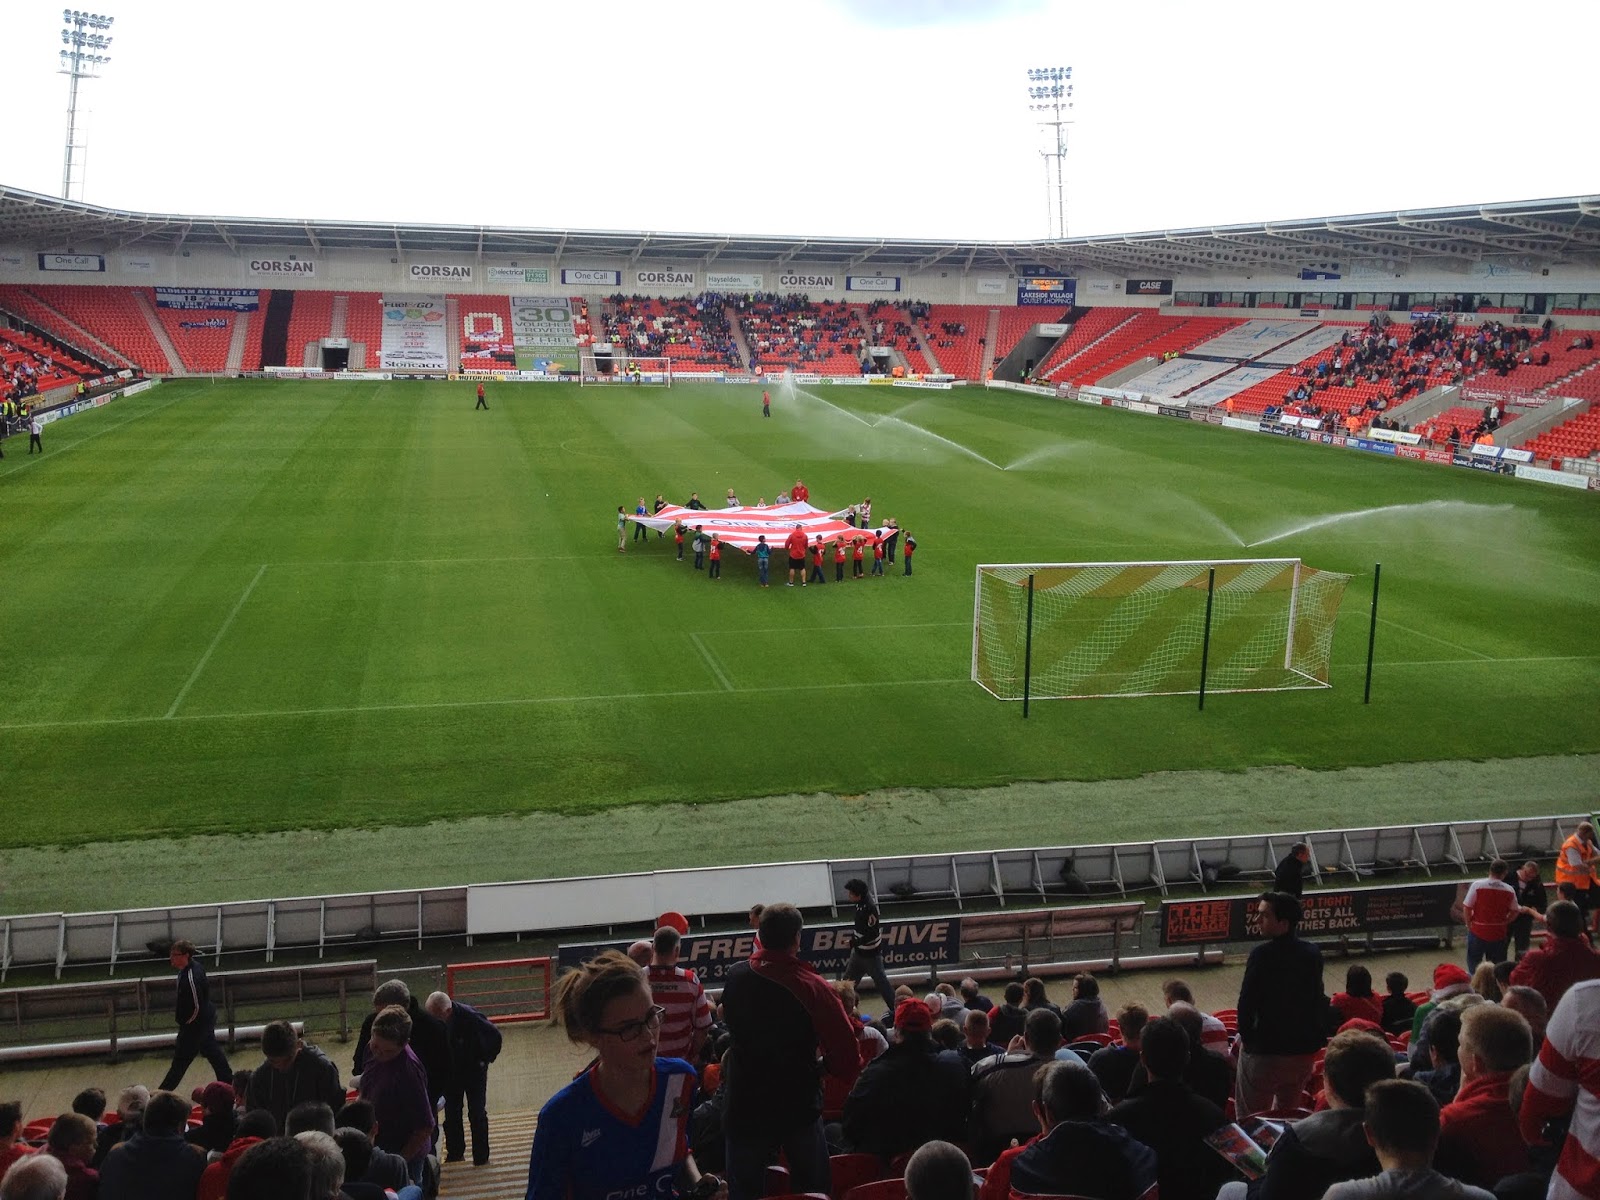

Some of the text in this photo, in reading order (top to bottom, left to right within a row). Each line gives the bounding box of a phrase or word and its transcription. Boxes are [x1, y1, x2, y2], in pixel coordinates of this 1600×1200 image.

[55, 256, 89, 265] One Call
[250, 260, 313, 272] CORSAN
[411, 265, 471, 277] CORSAN
[574, 271, 608, 280] One Call
[637, 272, 693, 283] CORSAN
[780, 275, 833, 286] CORSAN
[1139, 281, 1162, 290] CASE
[385, 360, 445, 369] Stoneacre
[1301, 430, 1321, 441] sky BET
[1322, 434, 1345, 445] sky BET
[1398, 446, 1420, 459] Pinders
[710, 519, 808, 528] One Call
[1318, 895, 1353, 907] TIGHT!
[1303, 908, 1332, 919] GETS
[1334, 906, 1355, 917] ALL
[1328, 917, 1361, 930] BACK.
